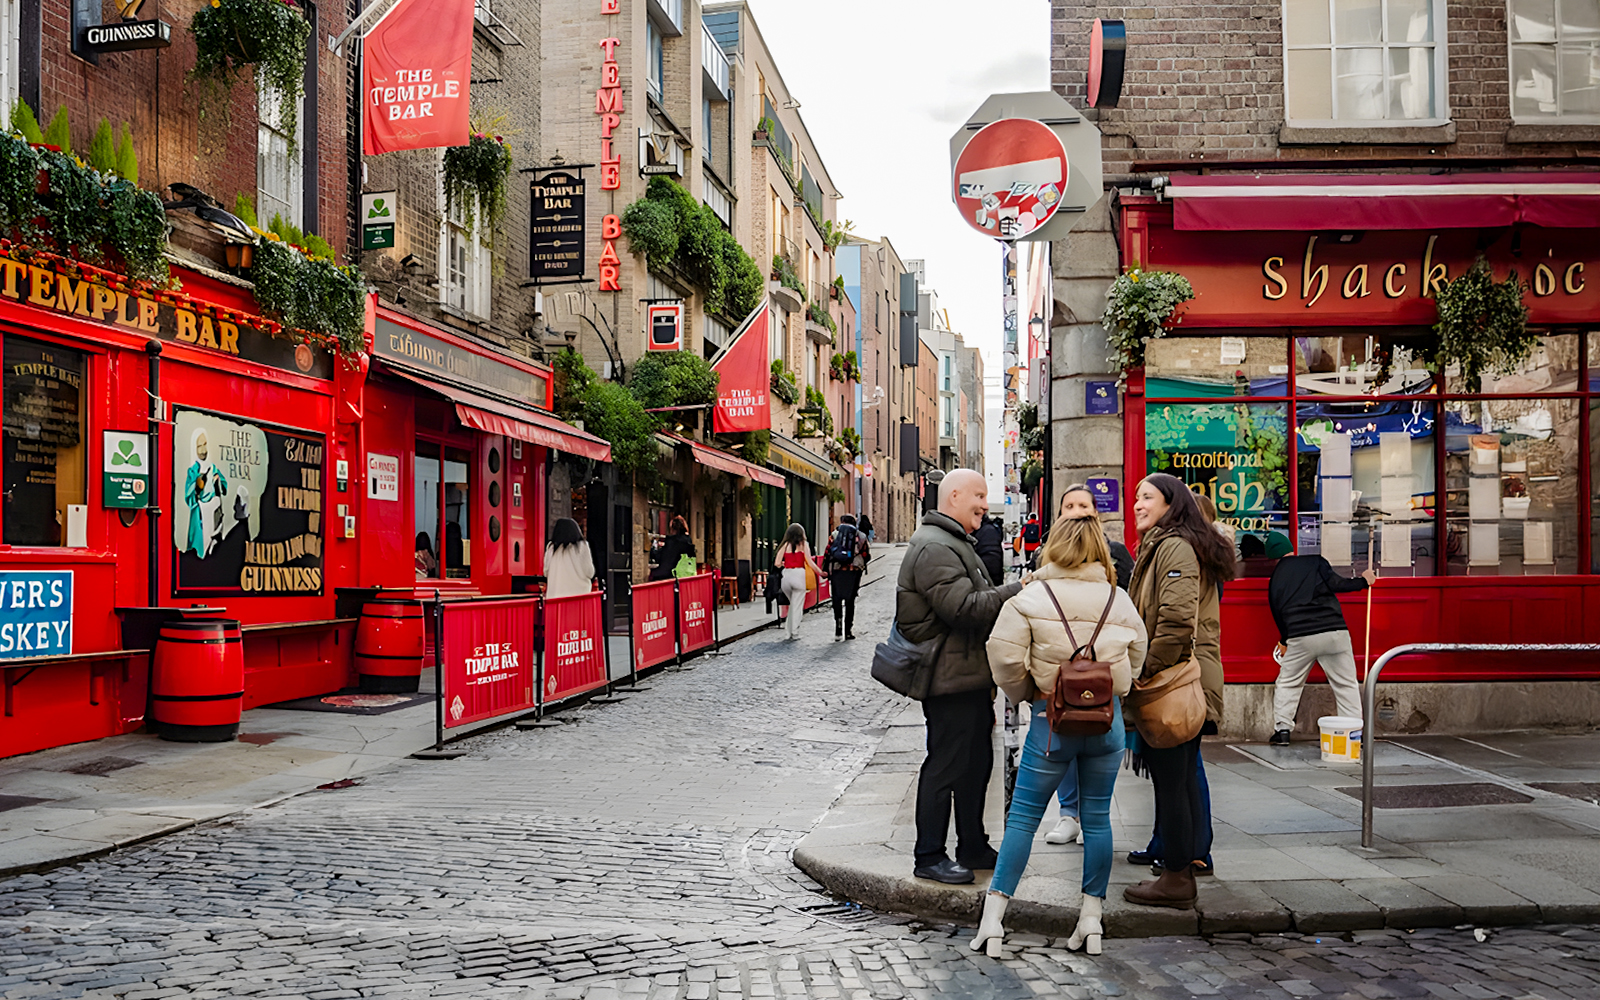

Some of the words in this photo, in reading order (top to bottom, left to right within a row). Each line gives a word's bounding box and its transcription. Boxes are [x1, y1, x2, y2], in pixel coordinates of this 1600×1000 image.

[88, 24, 155, 43] GUINNESS
[395, 69, 432, 83] THE
[370, 80, 460, 106] TEMPLE
[389, 102, 433, 121] BAR
[595, 37, 624, 190] TEMPLE
[599, 214, 622, 291] BAR
[0, 257, 160, 334] TEMPLE
[176, 308, 240, 355] BAR
[230, 430, 252, 448] THE
[240, 567, 322, 592] GUINNESS
[0, 579, 63, 609] ER'S
[0, 621, 69, 652] SKEY
